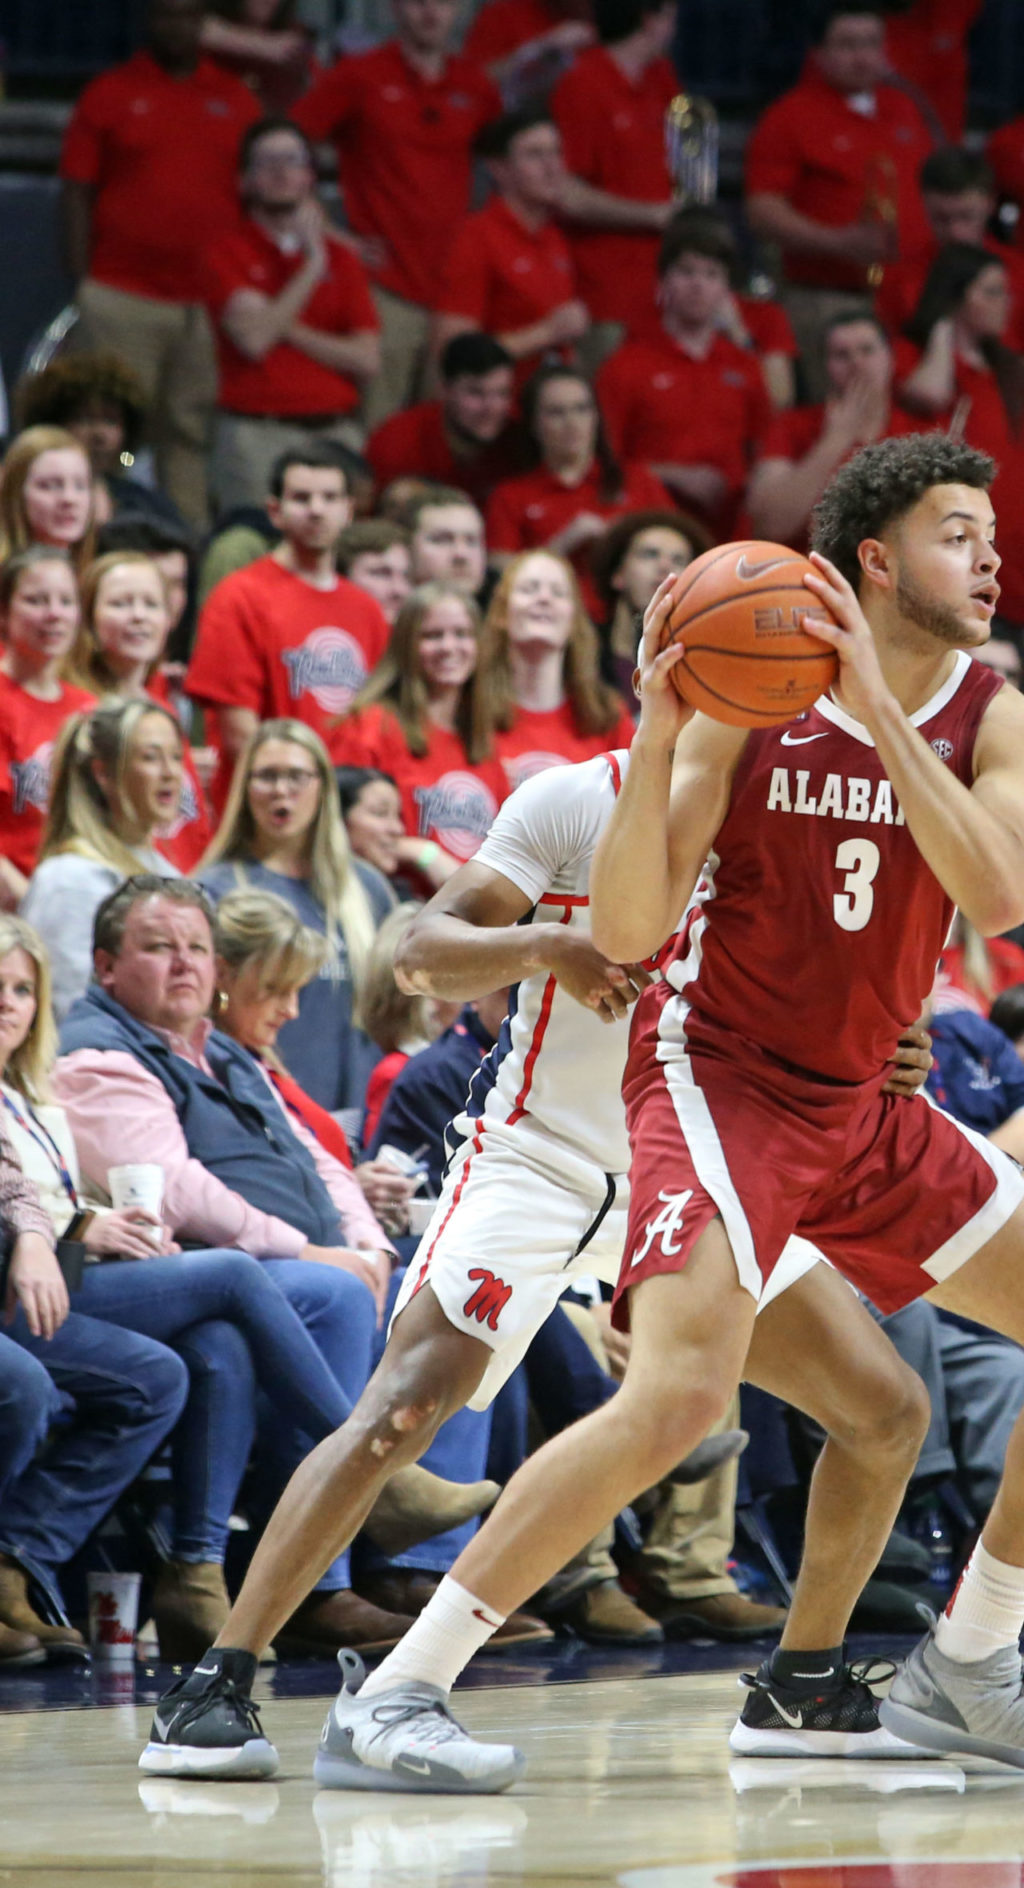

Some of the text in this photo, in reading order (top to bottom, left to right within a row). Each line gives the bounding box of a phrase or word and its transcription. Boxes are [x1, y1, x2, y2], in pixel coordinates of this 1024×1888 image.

[766, 767, 905, 826] ALABA
[832, 837, 881, 932] 3
[630, 1188, 694, 1268] A
